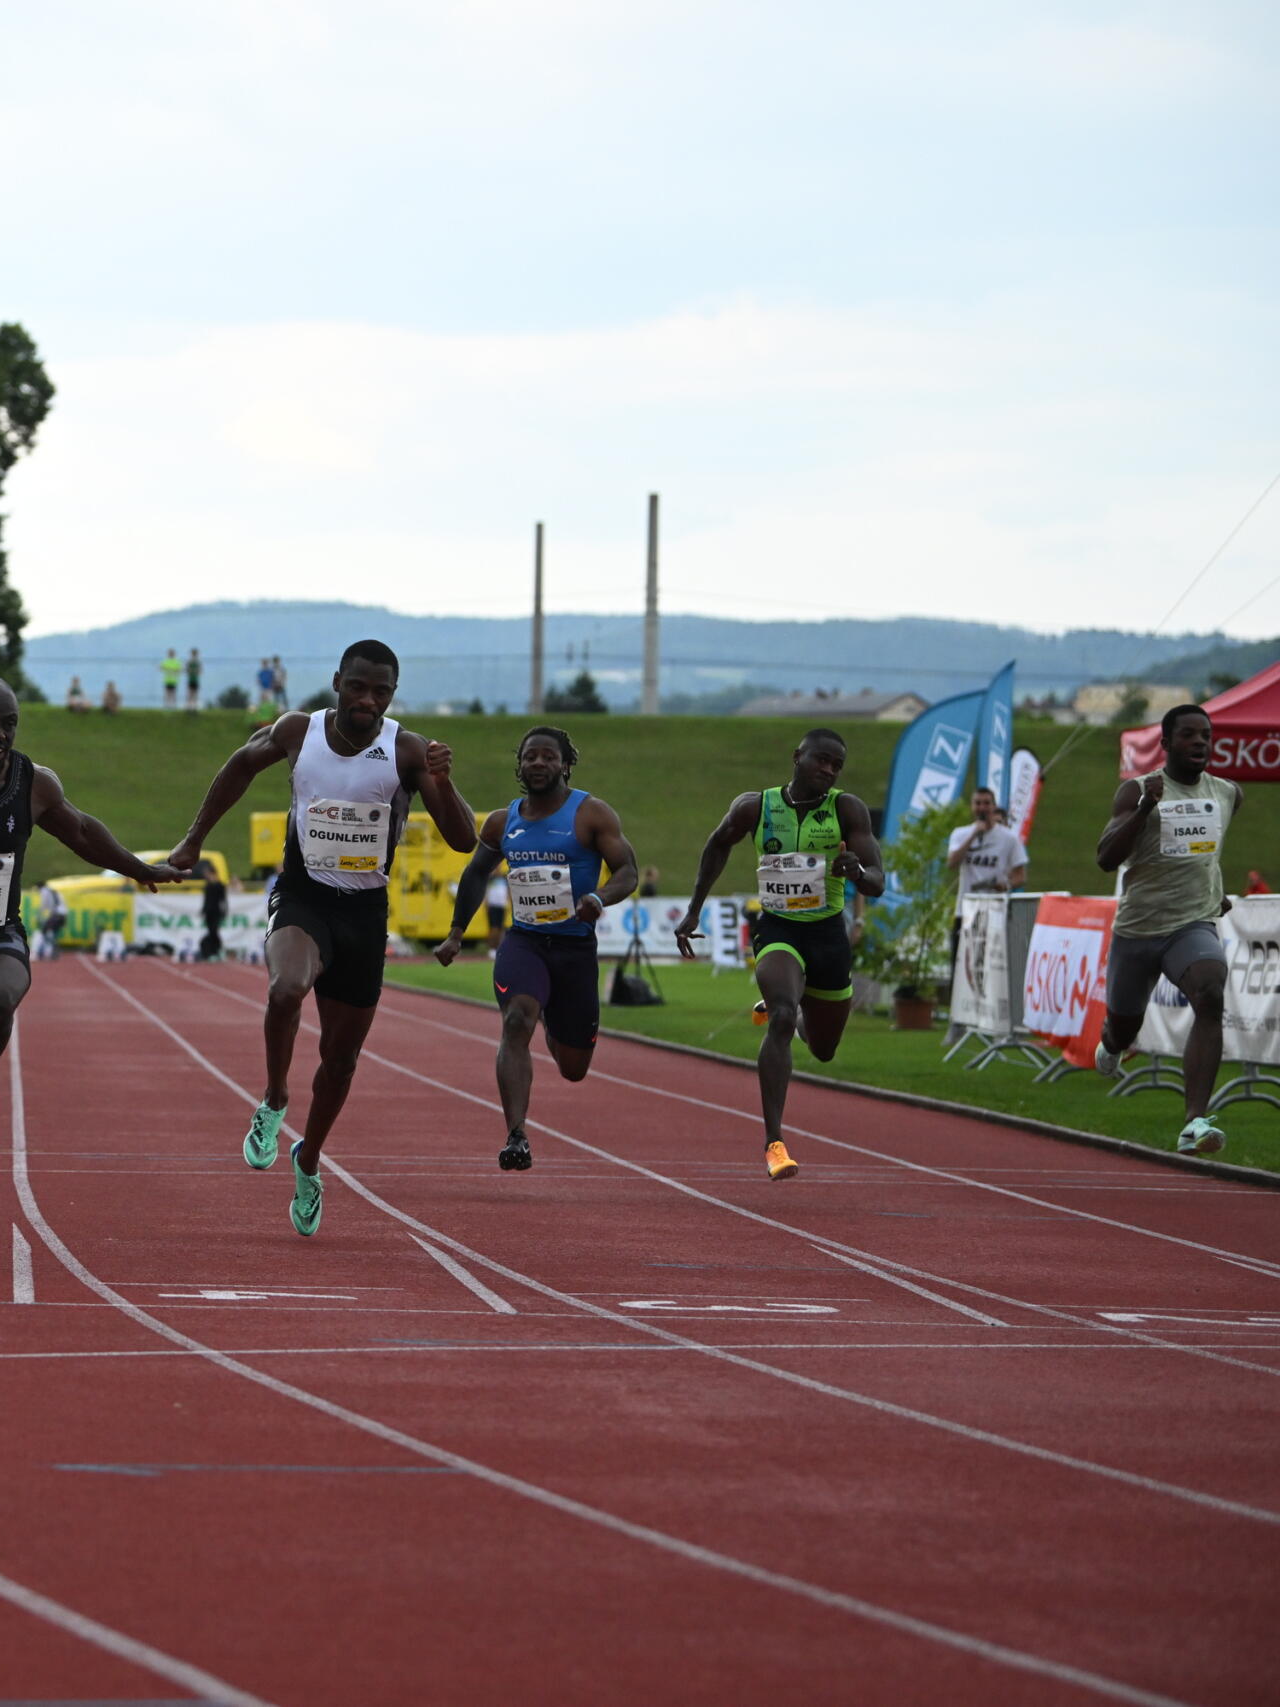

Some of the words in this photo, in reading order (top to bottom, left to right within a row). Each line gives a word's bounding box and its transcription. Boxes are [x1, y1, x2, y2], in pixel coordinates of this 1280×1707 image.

[1209, 732, 1280, 768] SKÖ
[365, 753, 389, 761] adidas
[309, 829, 378, 843] OGUNLEWE
[1174, 826, 1207, 837] ISAAC
[508, 851, 566, 862] SCOTLAND
[766, 882, 813, 895] KEITA
[519, 895, 556, 906] AIKEN
[1025, 938, 1069, 1013] ASKÖ
